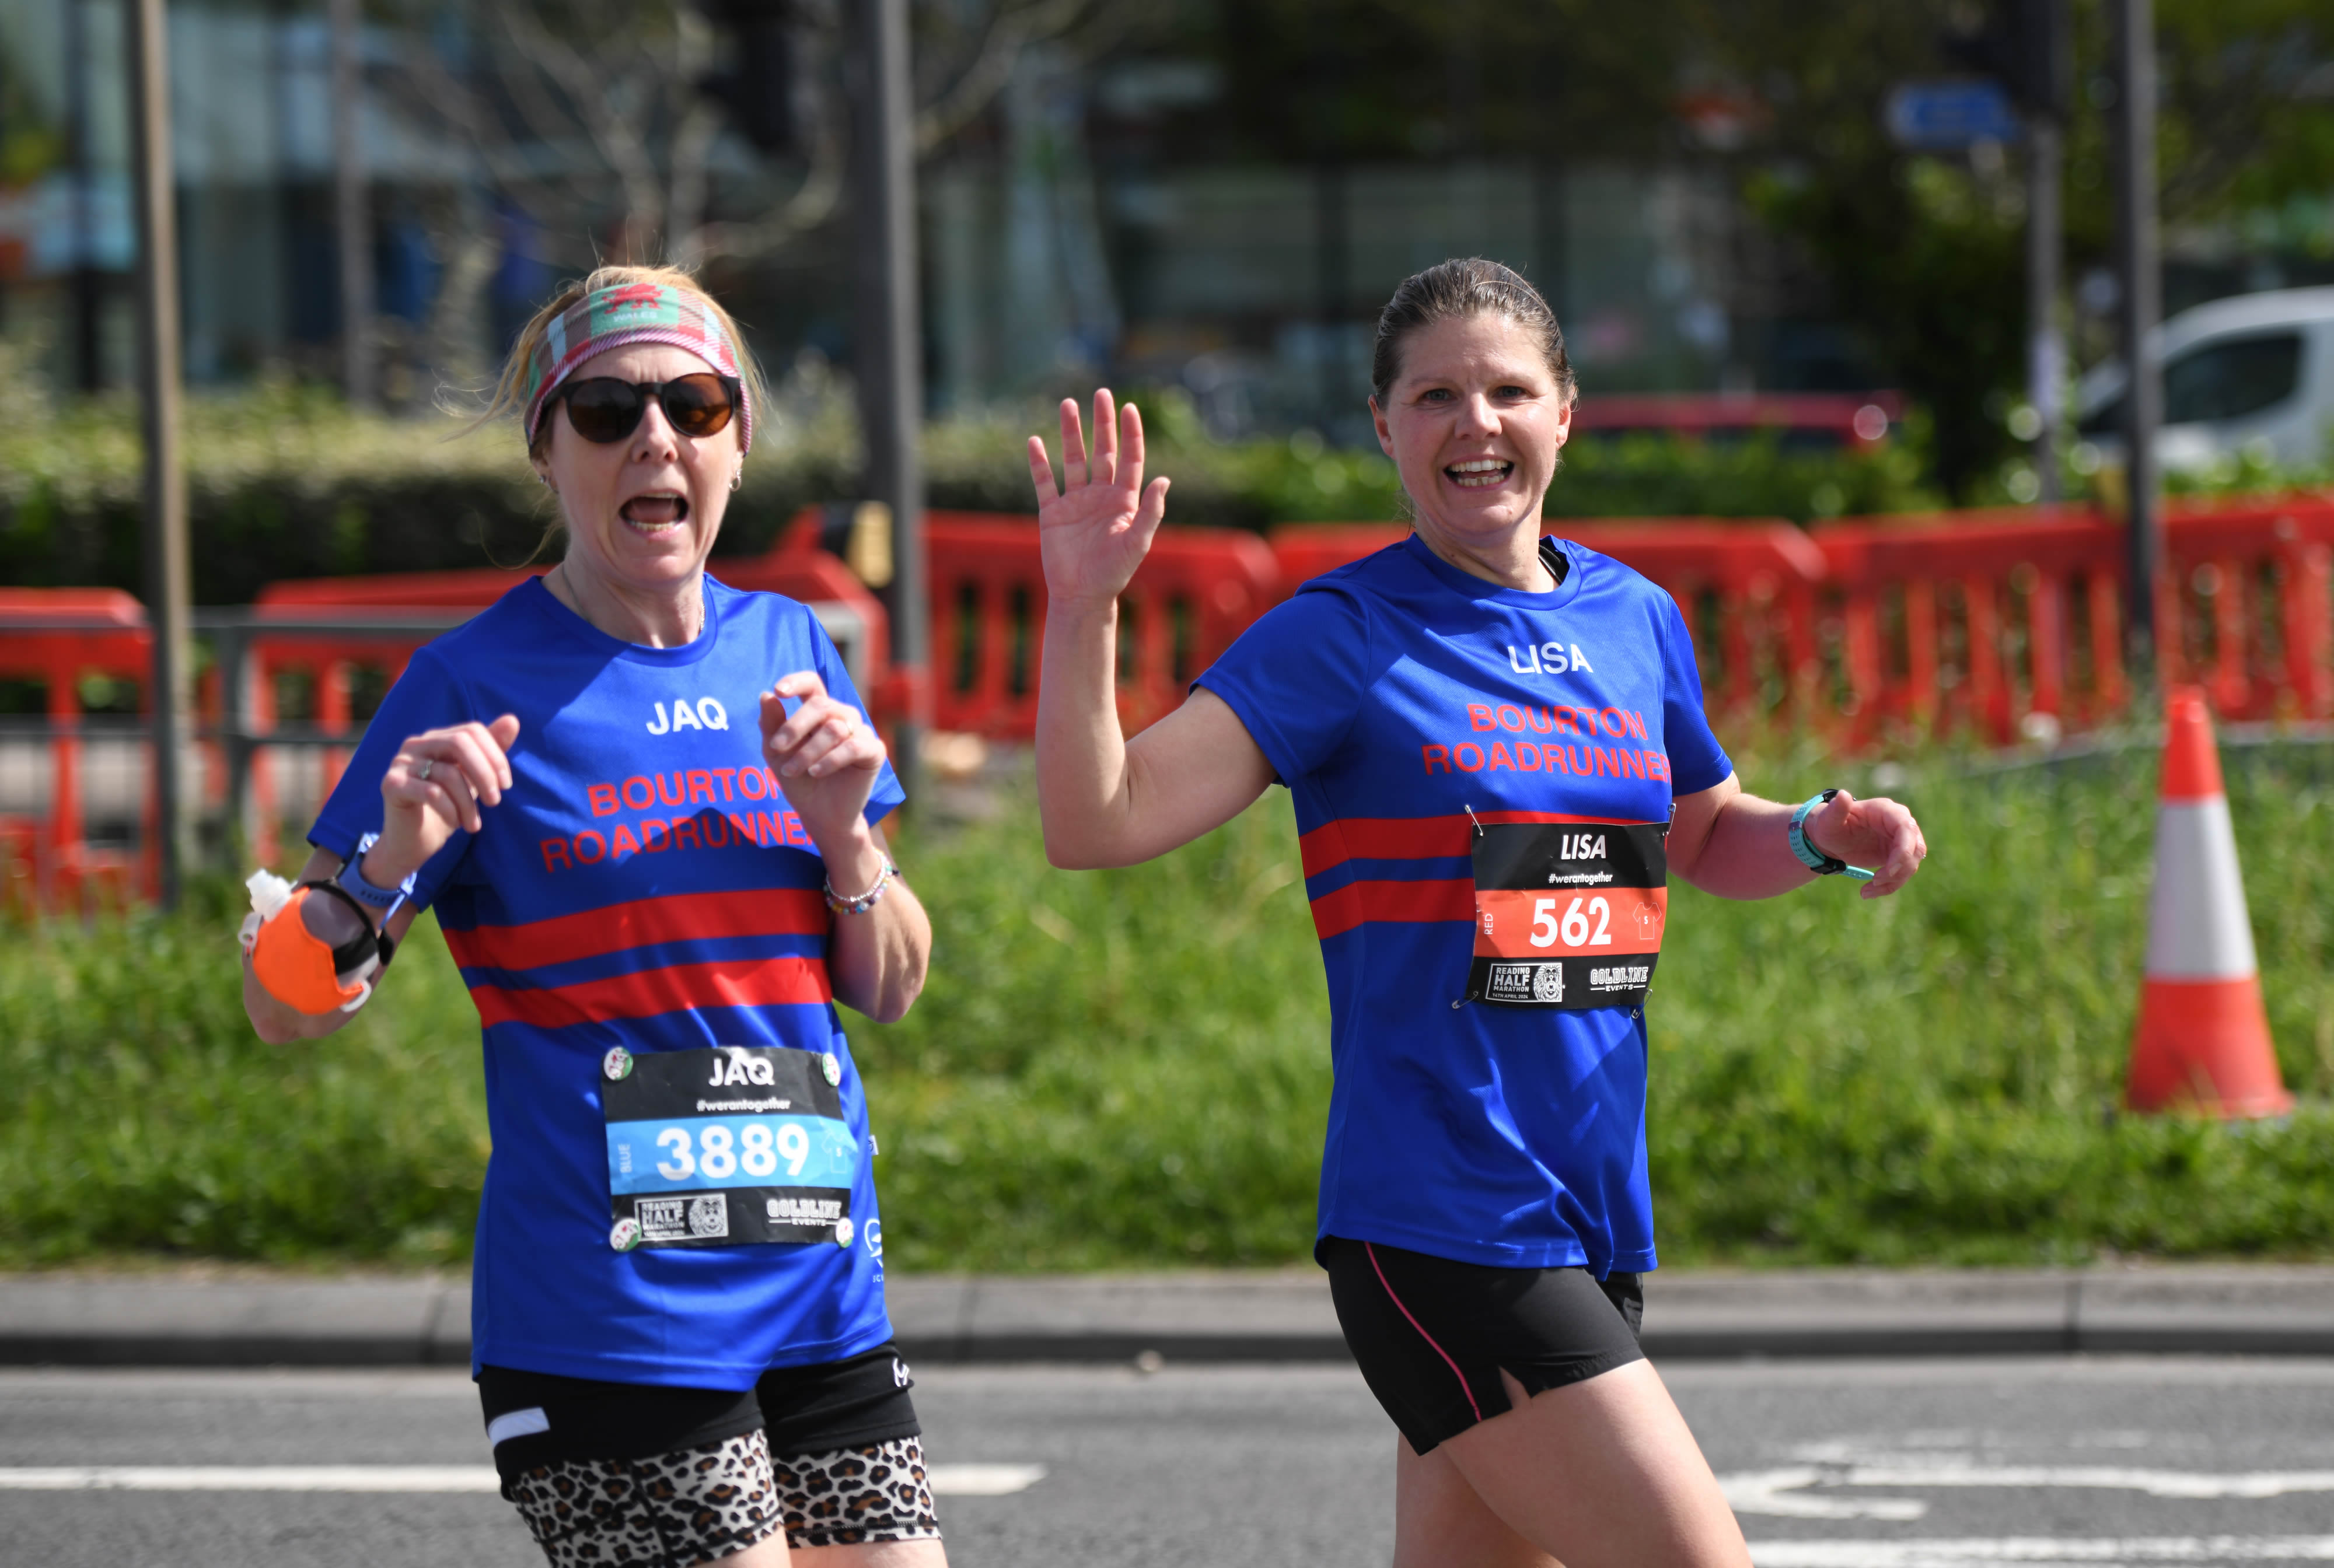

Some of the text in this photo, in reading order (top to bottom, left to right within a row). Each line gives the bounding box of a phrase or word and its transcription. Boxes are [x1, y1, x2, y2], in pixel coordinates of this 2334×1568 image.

[613, 311, 658, 322] WALES
[1507, 642, 1594, 674] LISA
[646, 696, 729, 735] JAQ
[1468, 704, 1648, 740] BOURTON
[540, 811, 812, 873] ROADRUNNE
[1561, 834, 1606, 860] LISA
[1549, 871, 1613, 886] #werantogether
[1484, 914, 1493, 935] RED
[1530, 897, 1612, 948] 562
[1494, 974, 1531, 986] HALF
[1591, 967, 1648, 985] GOLDLINE
[708, 1056, 775, 1087] JAQ
[697, 1097, 791, 1113] #werantogether
[618, 1143, 633, 1172] BLUE
[656, 1123, 810, 1181] 3889
[642, 1209, 683, 1225] HALF
[767, 1199, 841, 1219] GOLDLINE
